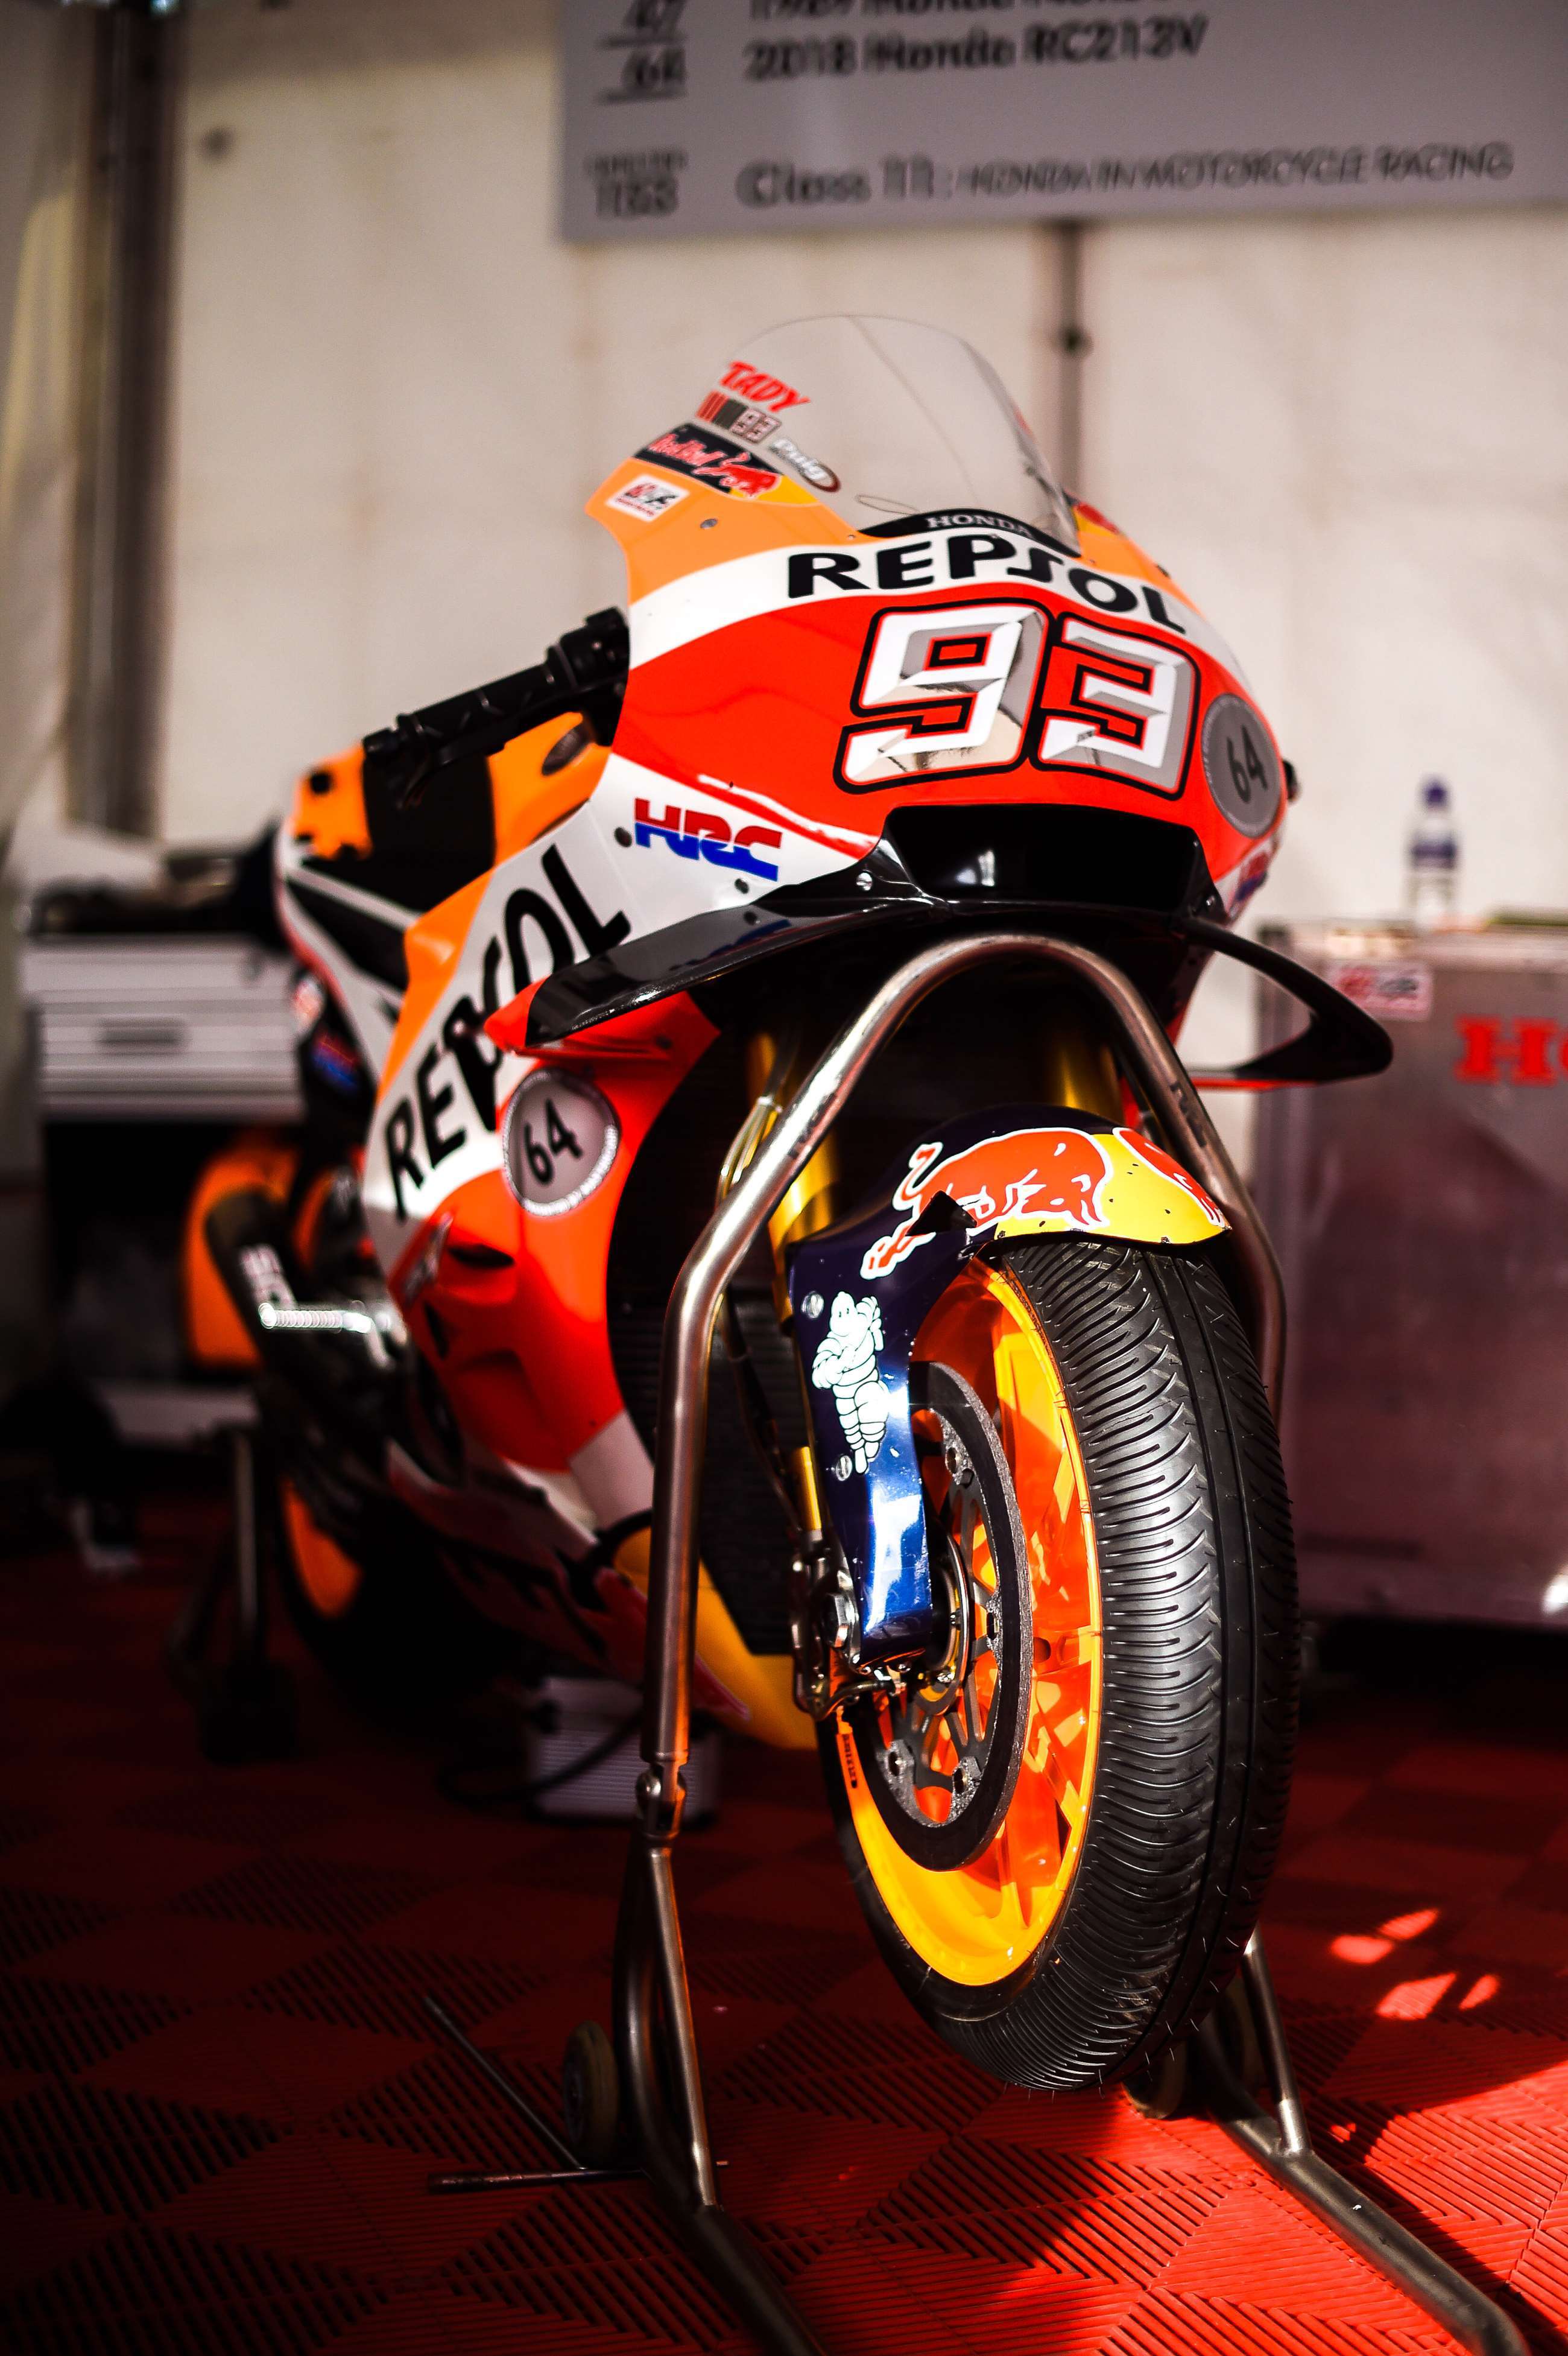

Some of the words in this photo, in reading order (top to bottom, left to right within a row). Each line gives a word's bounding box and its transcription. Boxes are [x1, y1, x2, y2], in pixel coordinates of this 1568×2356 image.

[743, 35, 857, 80] 2018
[864, 27, 1017, 72] Honda
[736, 158, 872, 208] Class
[1376, 140, 1515, 182] RACING
[719, 361, 811, 413] TADY
[730, 408, 782, 443] 93
[926, 514, 1035, 540] HONDA
[788, 533, 1187, 634] REPSOL
[833, 597, 1201, 800] 93
[1227, 726, 1266, 803] 64
[634, 797, 783, 882] HRC
[523, 1100, 583, 1185] 64
